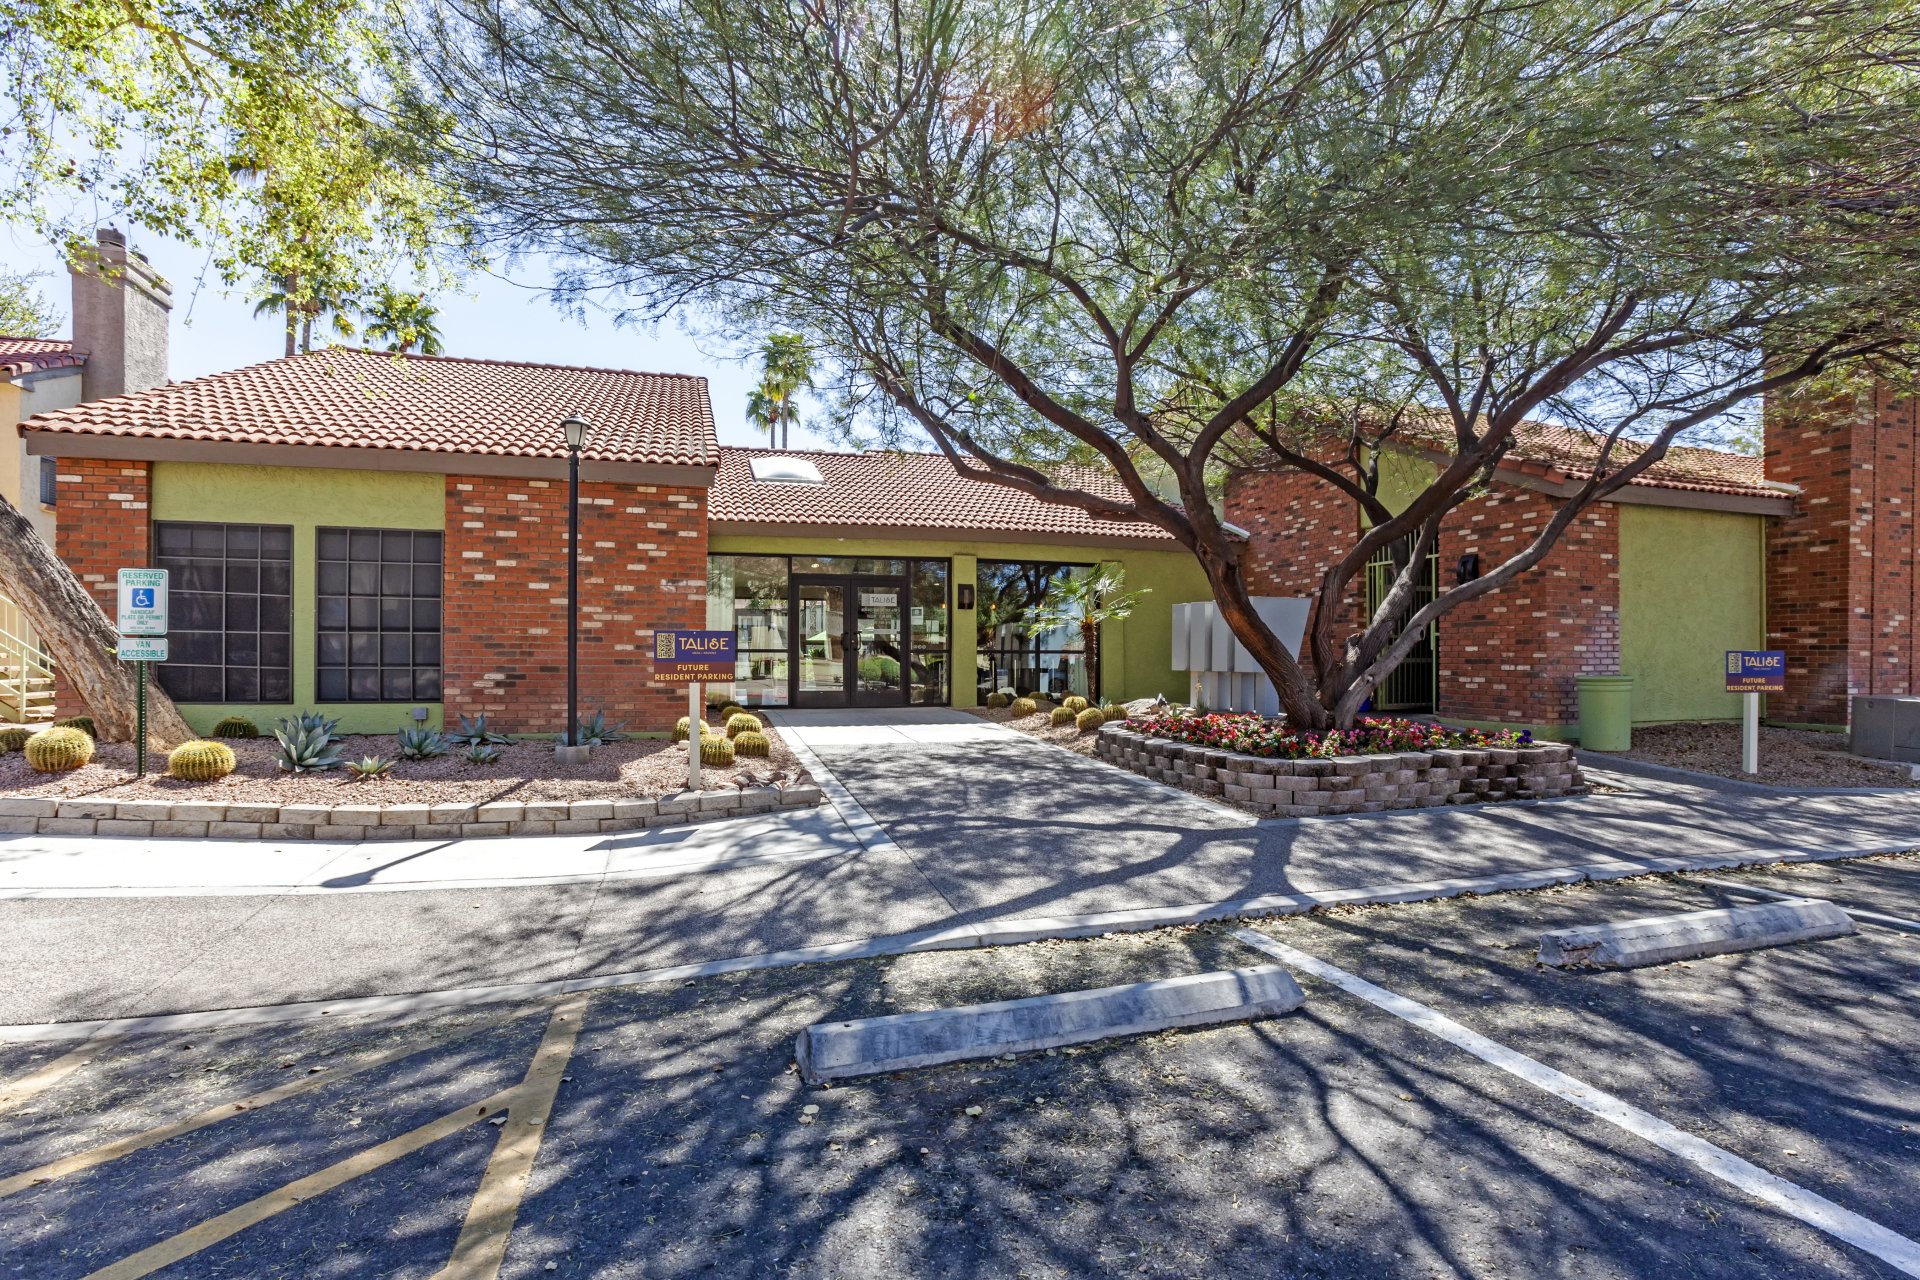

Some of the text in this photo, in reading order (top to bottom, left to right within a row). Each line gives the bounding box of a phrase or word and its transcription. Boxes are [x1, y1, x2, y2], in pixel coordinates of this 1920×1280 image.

[136, 640, 151, 648] VAN
[678, 637, 729, 650] TALISE
[121, 649, 165, 658] ACCESSIBLE
[1743, 656, 1781, 667] TALISE
[654, 673, 695, 681] RESIDENT
